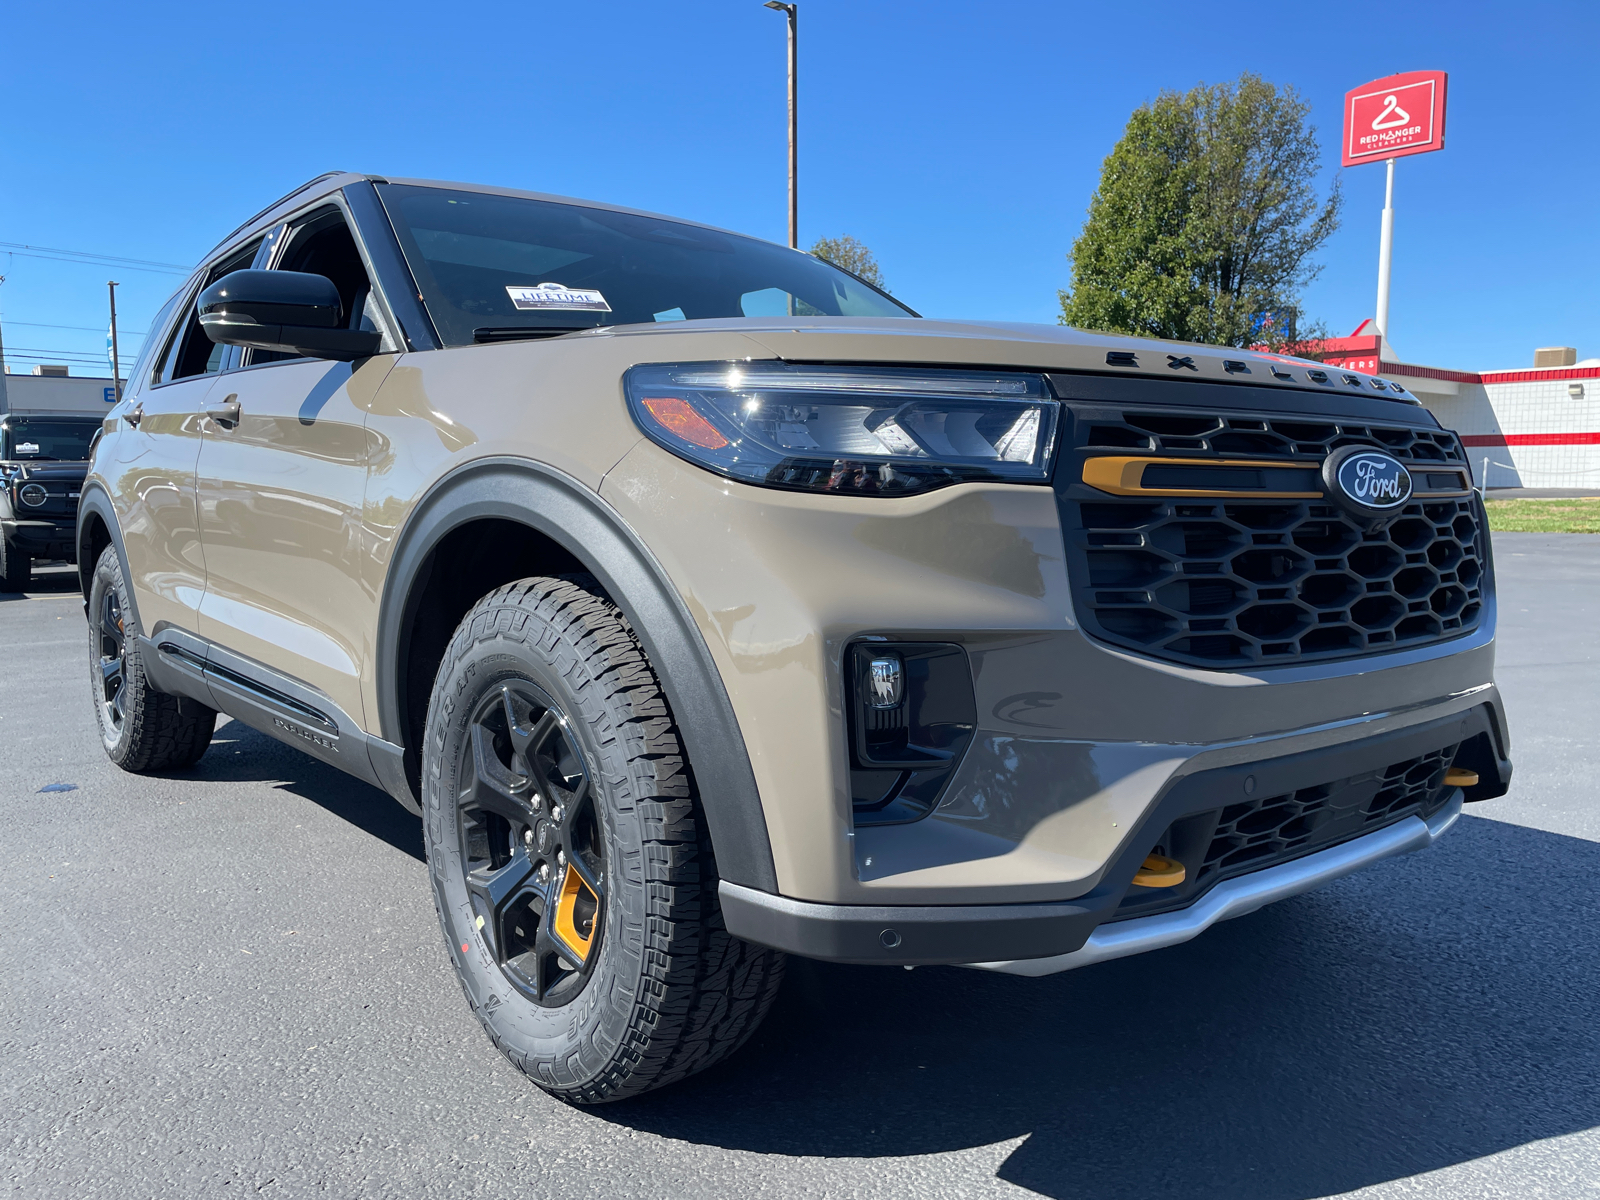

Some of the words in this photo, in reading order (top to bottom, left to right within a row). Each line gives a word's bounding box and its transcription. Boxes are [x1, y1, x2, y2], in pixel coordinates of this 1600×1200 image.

[1360, 134, 1379, 144] RED
[1379, 126, 1421, 141] HANGER
[1367, 136, 1413, 149] CLEANERS
[521, 292, 592, 302] LIFETIME
[1105, 351, 1405, 394] EXPLORER
[1354, 460, 1401, 498] Ford
[272, 717, 340, 753] EXPLORER
[430, 695, 455, 882] DUELER
[456, 660, 476, 696] A/T
